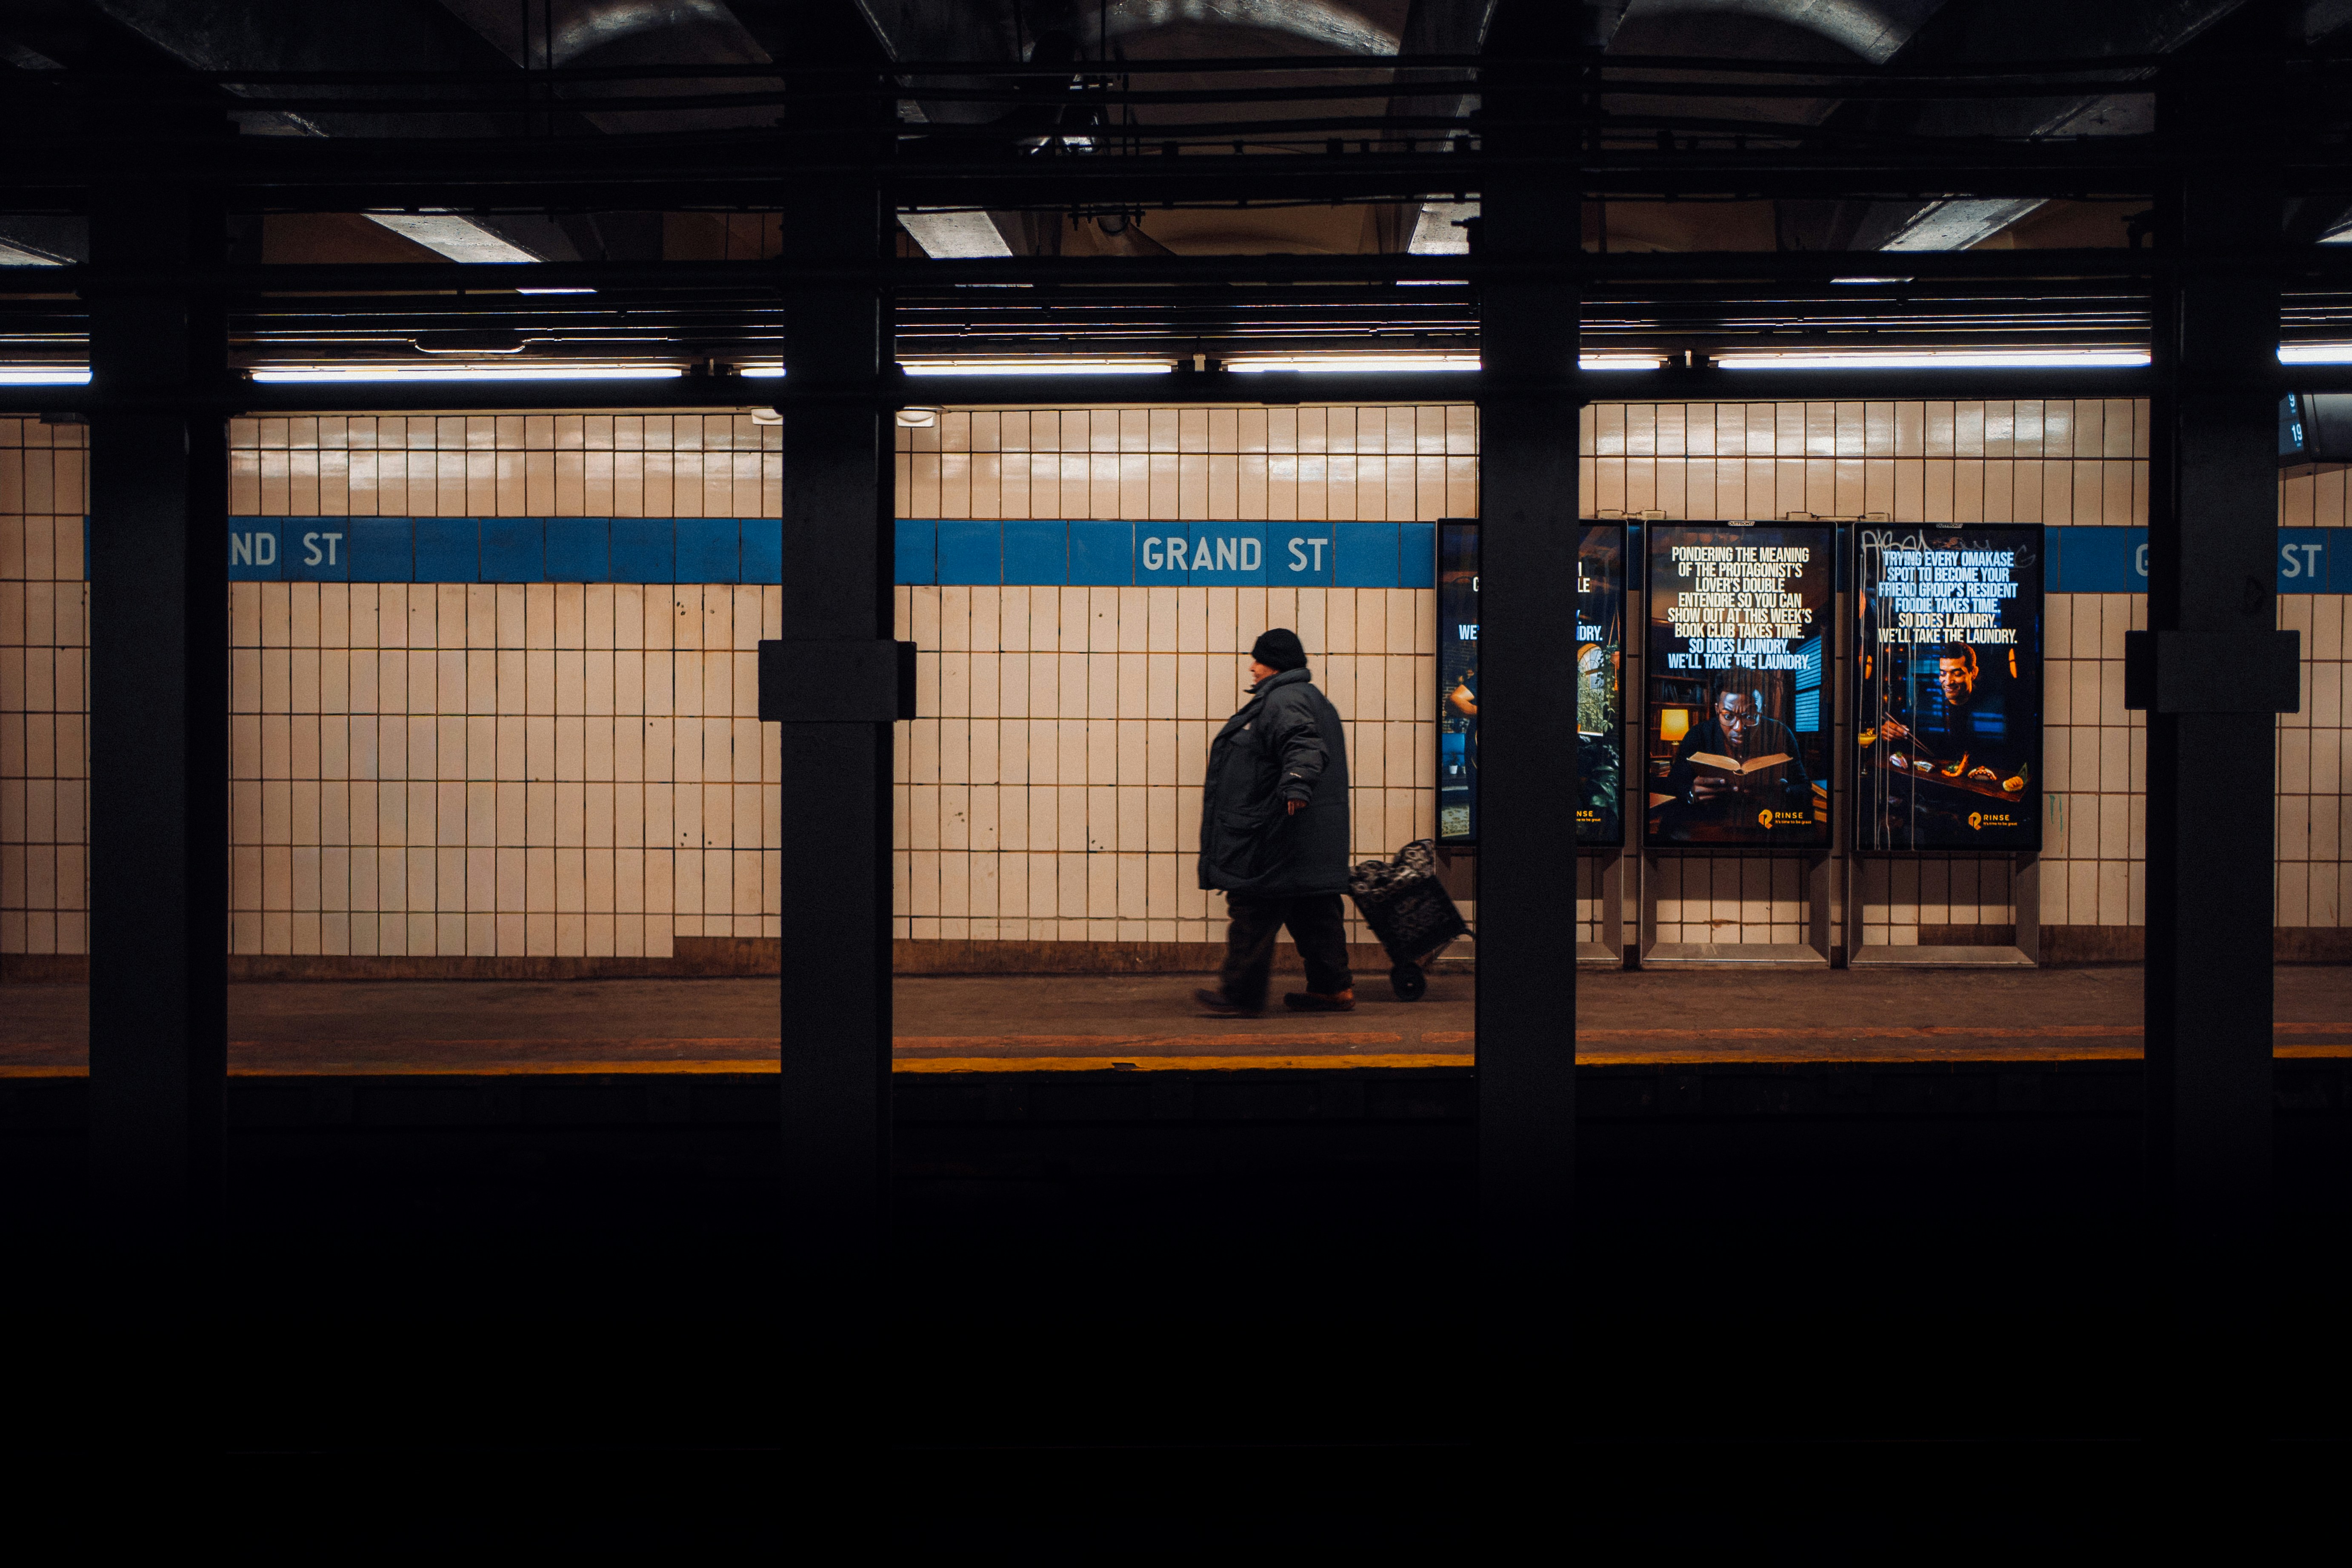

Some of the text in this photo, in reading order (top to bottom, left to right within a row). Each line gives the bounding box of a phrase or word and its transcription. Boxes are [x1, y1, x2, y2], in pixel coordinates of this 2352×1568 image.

[2291, 423, 2303, 441] 19
[232, 532, 343, 566] ND ST
[1143, 537, 1328, 571] GRAND ST
[1672, 546, 1809, 562] PONDERING THE MEANING
[1883, 551, 1921, 566] TRYING
[1924, 552, 1959, 566] EVERY
[1961, 552, 2014, 567] OMAKASE
[2281, 544, 2322, 578] ST
[1678, 562, 1802, 577] OF THE PROTAGONIST'S
[1887, 567, 2009, 582] SPOT TO BECOME YOUR
[1578, 577, 1590, 592] LE
[1695, 577, 1785, 592] LOVER'S DOUBLE
[1878, 582, 2018, 598] FRIEND GROUP'S RESIDENT
[1678, 593, 1801, 608] ENTENDRE SO YOU CAN
[1895, 598, 2000, 613] FOODIE TAKES TIME.
[1668, 608, 1812, 623] SHOW OUT AT THIS WEEK'S
[1898, 613, 1997, 628] SO DOES LAUNDRY.
[1459, 624, 1480, 640] WE'
[1576, 625, 1603, 640] DRY.
[1675, 623, 1804, 638] BOOK CLUB TAKES TIME.
[1878, 628, 2017, 643] WE'LL TAKE THE LAUNDRY.
[1689, 639, 1789, 654] SO DOES LAUNDRY.
[1668, 654, 1811, 669] WE'LL TAKE THE LAUNDRY.
